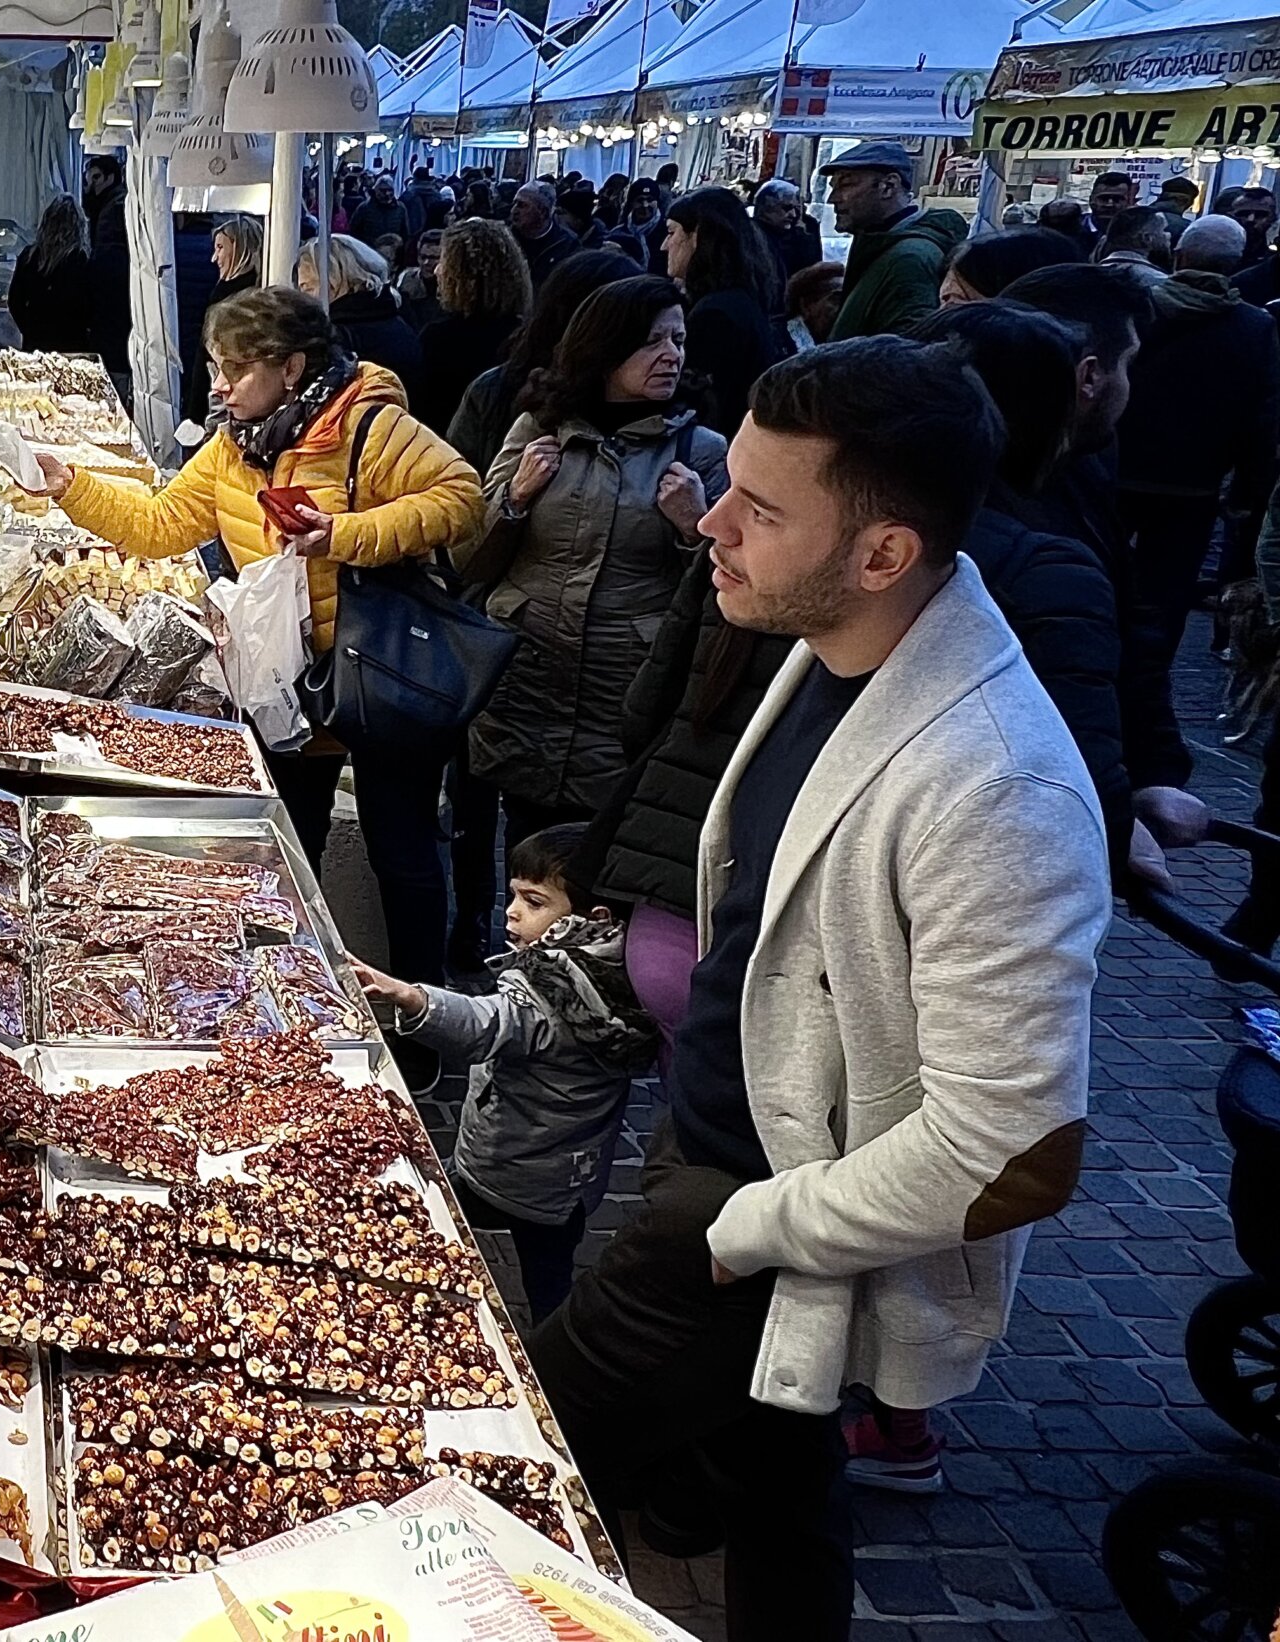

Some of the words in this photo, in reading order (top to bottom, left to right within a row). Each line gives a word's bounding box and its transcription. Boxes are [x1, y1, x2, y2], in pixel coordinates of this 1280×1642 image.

[982, 109, 1176, 150] TORRONE
[532, 1561, 570, 1583] 1928
[570, 1576, 598, 1595] dal
